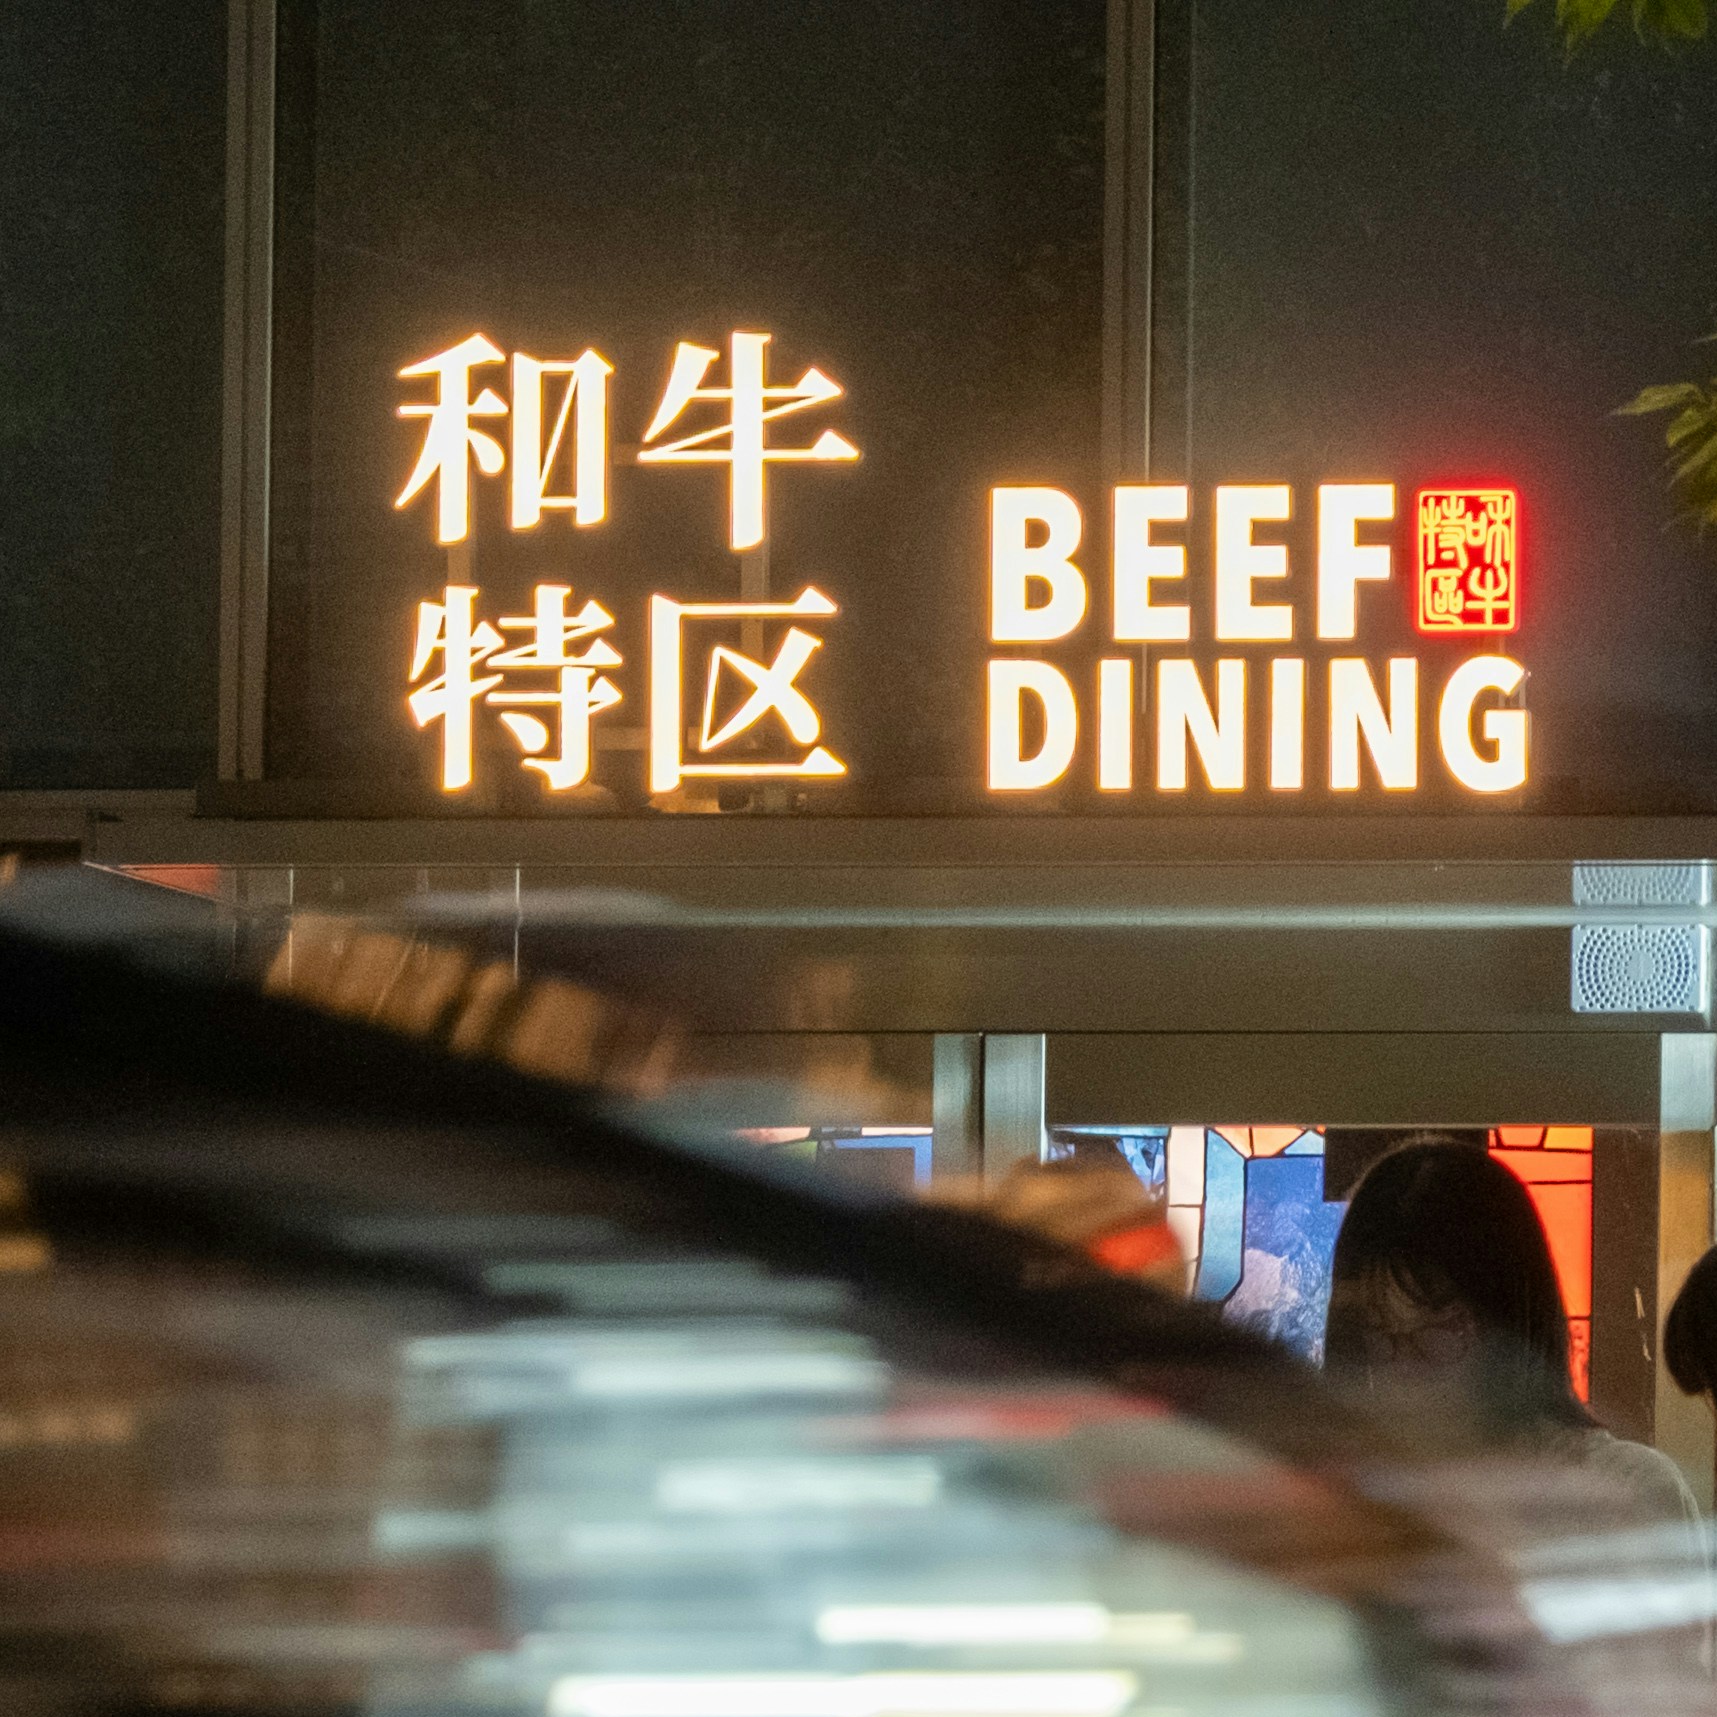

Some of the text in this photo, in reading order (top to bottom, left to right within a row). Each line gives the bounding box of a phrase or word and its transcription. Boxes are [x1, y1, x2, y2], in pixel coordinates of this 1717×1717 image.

[395, 331, 859, 552] 和牛
[989, 483, 1398, 642] BEEF
[409, 584, 847, 792] 特区
[987, 657, 1531, 793] DINING
